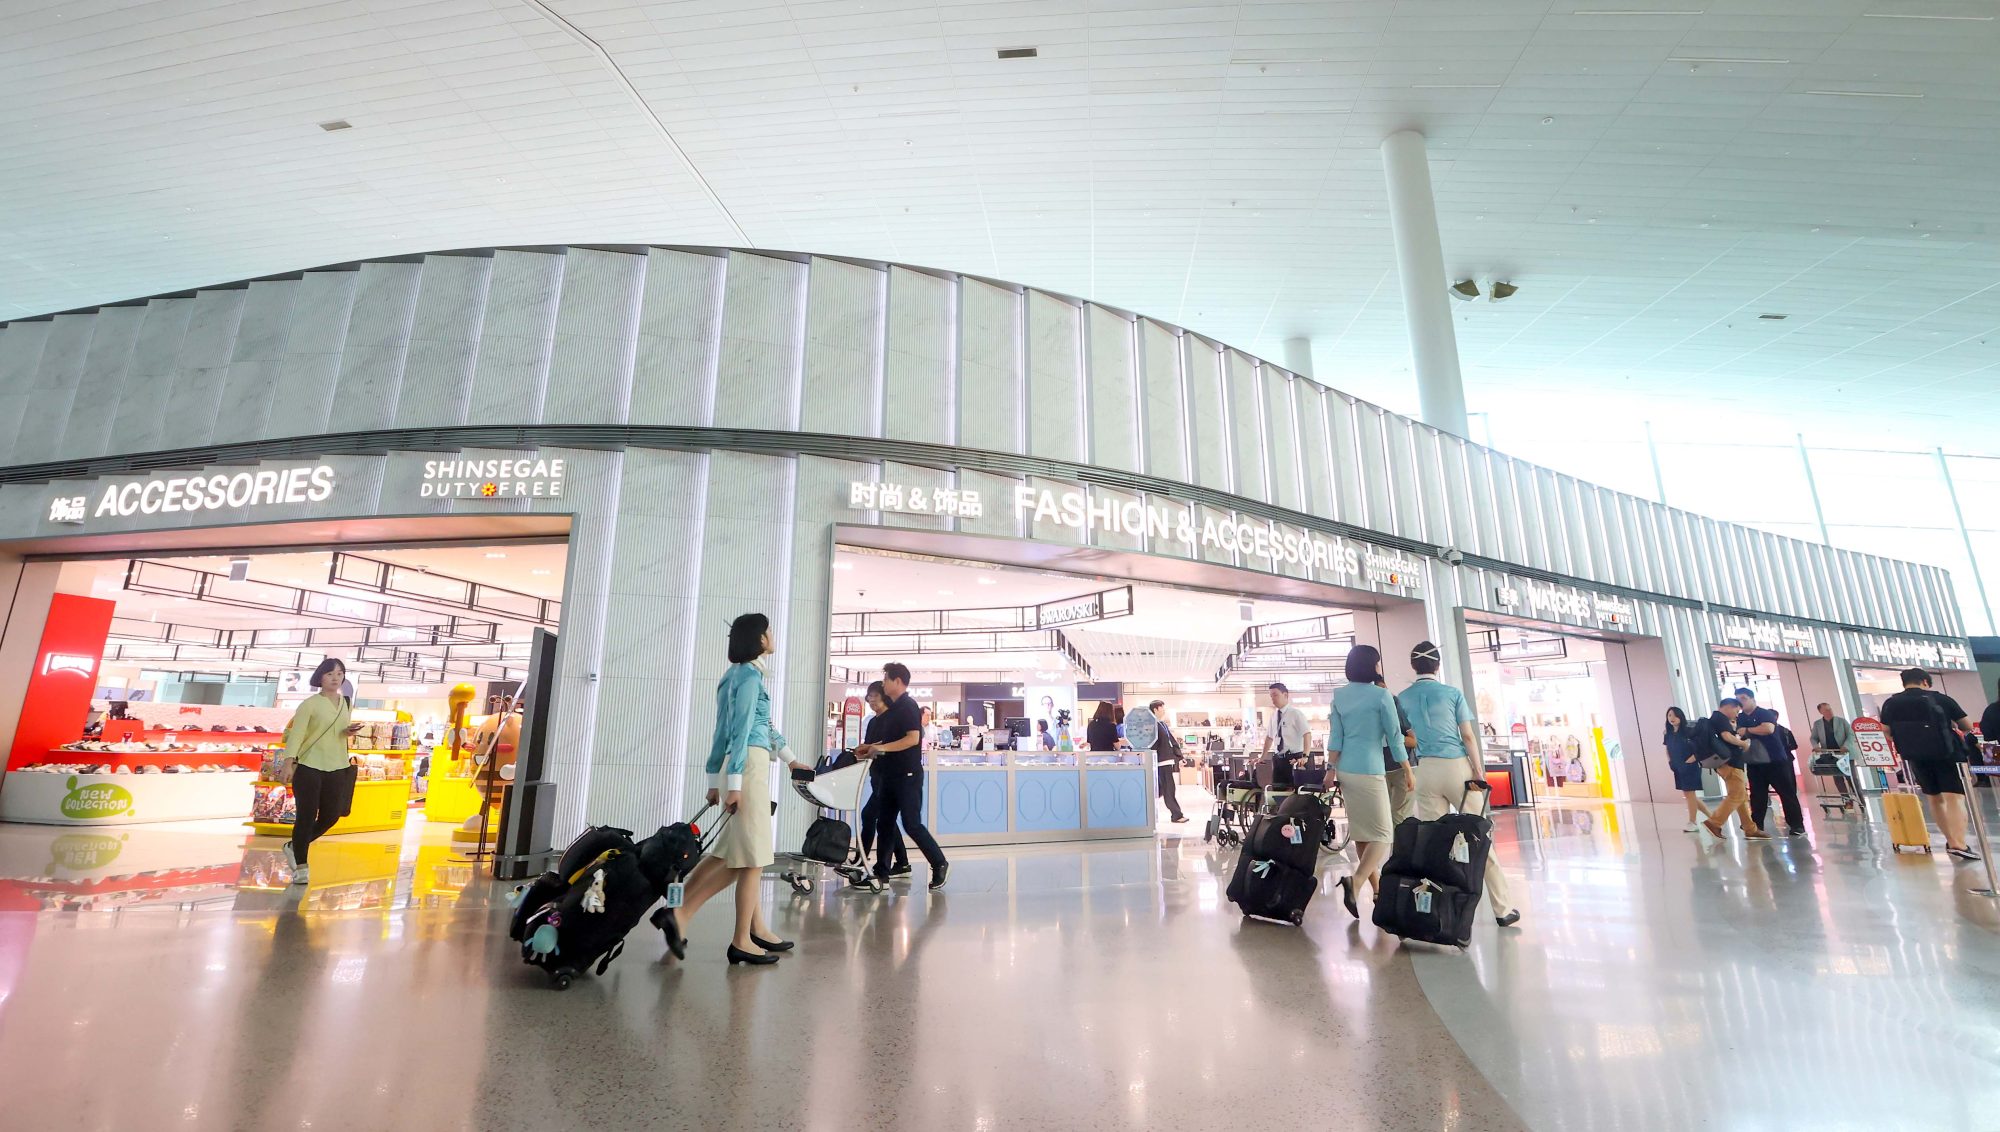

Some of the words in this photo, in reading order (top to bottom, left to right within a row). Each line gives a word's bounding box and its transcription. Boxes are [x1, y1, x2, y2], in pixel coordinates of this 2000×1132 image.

[423, 459, 564, 479] SHINSEGAE
[94, 465, 335, 519] ACCESSORIES
[420, 482, 481, 497] DUTY
[498, 481, 561, 496] FREE
[850, 481, 903, 511] 时尚
[908, 487, 927, 511] &
[932, 487, 983, 517] 饰品
[1014, 485, 1169, 540] FASHION
[1176, 510, 1198, 544] &
[1201, 516, 1359, 576] ACCESSORIES
[1365, 553, 1420, 576] SHINSEGAE
[1366, 568, 1392, 584] DUTY
[1397, 573, 1421, 589] FREE
[1040, 602, 1097, 624] SWAROVSKI
[1860, 741, 1883, 752] 50
